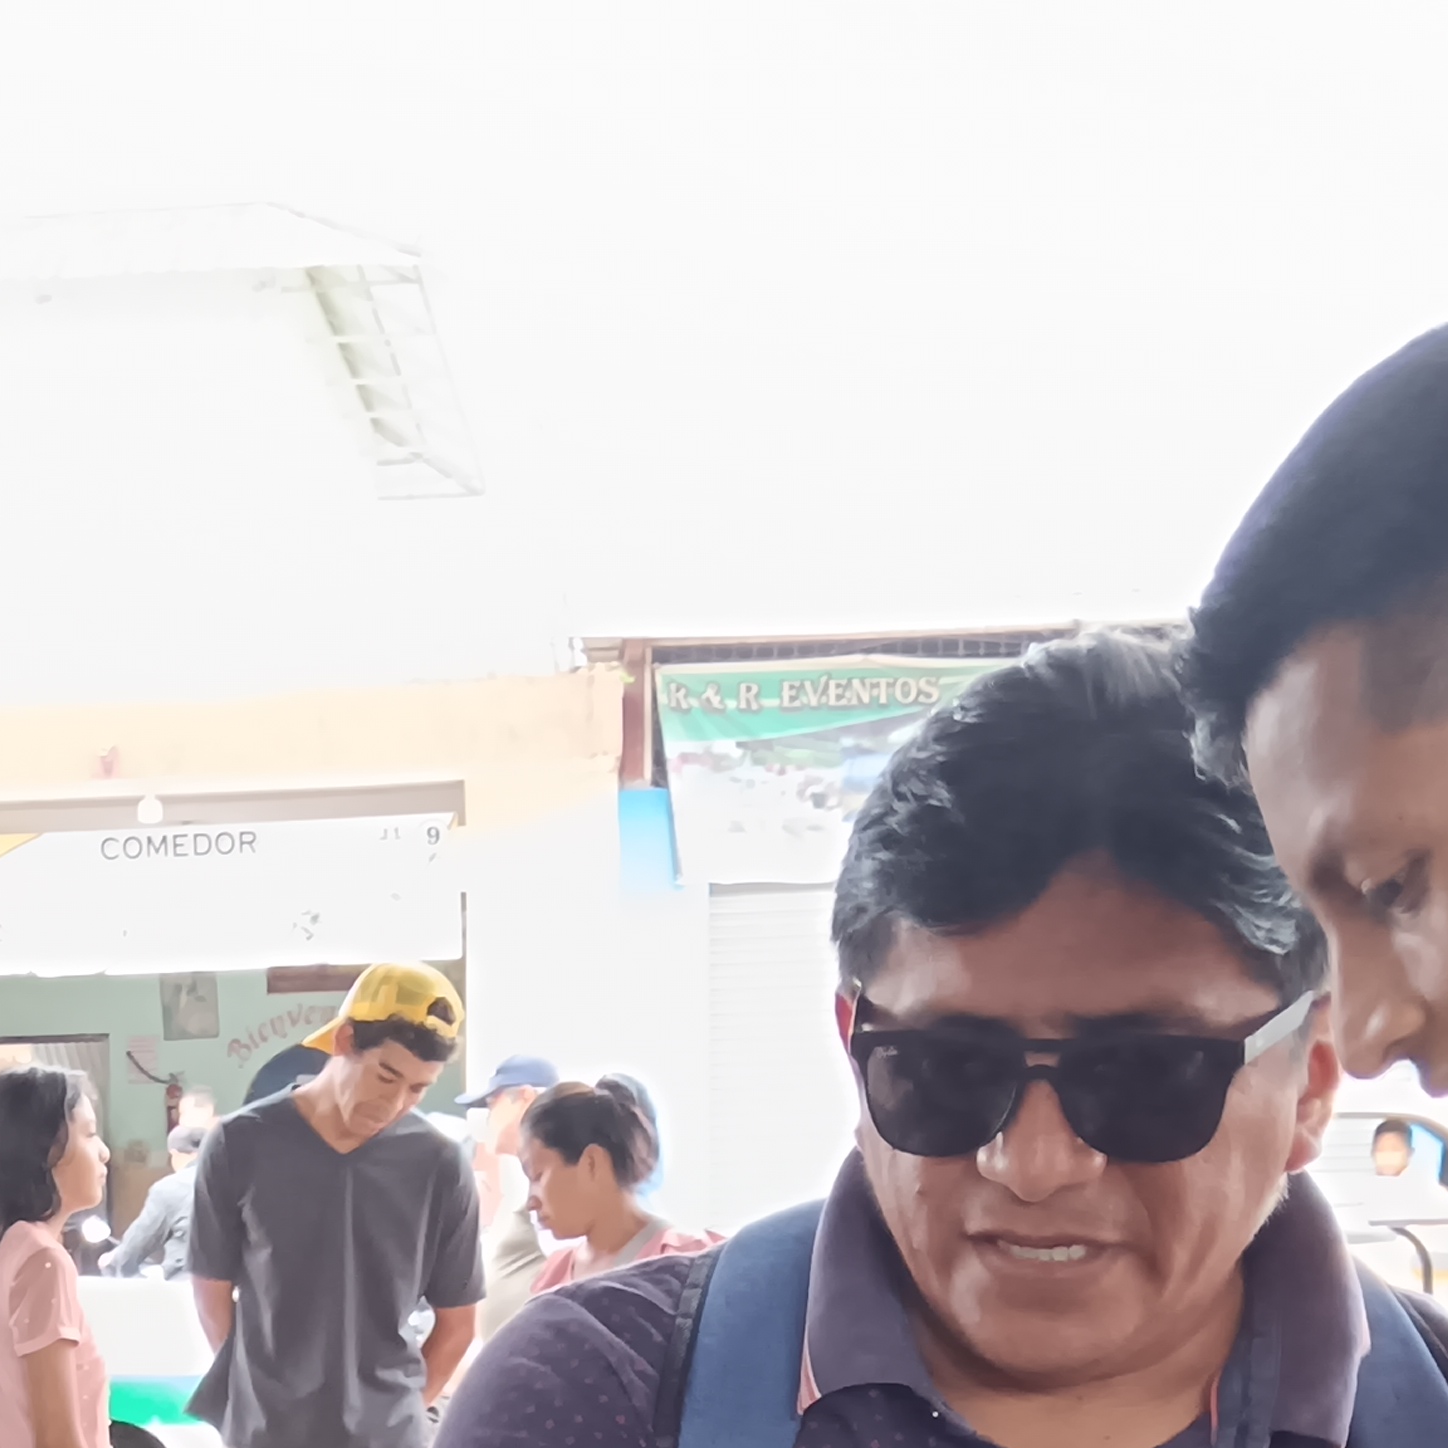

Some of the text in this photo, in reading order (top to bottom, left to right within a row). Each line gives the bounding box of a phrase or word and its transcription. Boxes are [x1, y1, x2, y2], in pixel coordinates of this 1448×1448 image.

[739, 681, 762, 710] R
[780, 674, 942, 710] EVENTOS
[99, 830, 259, 861] COMEDOR
